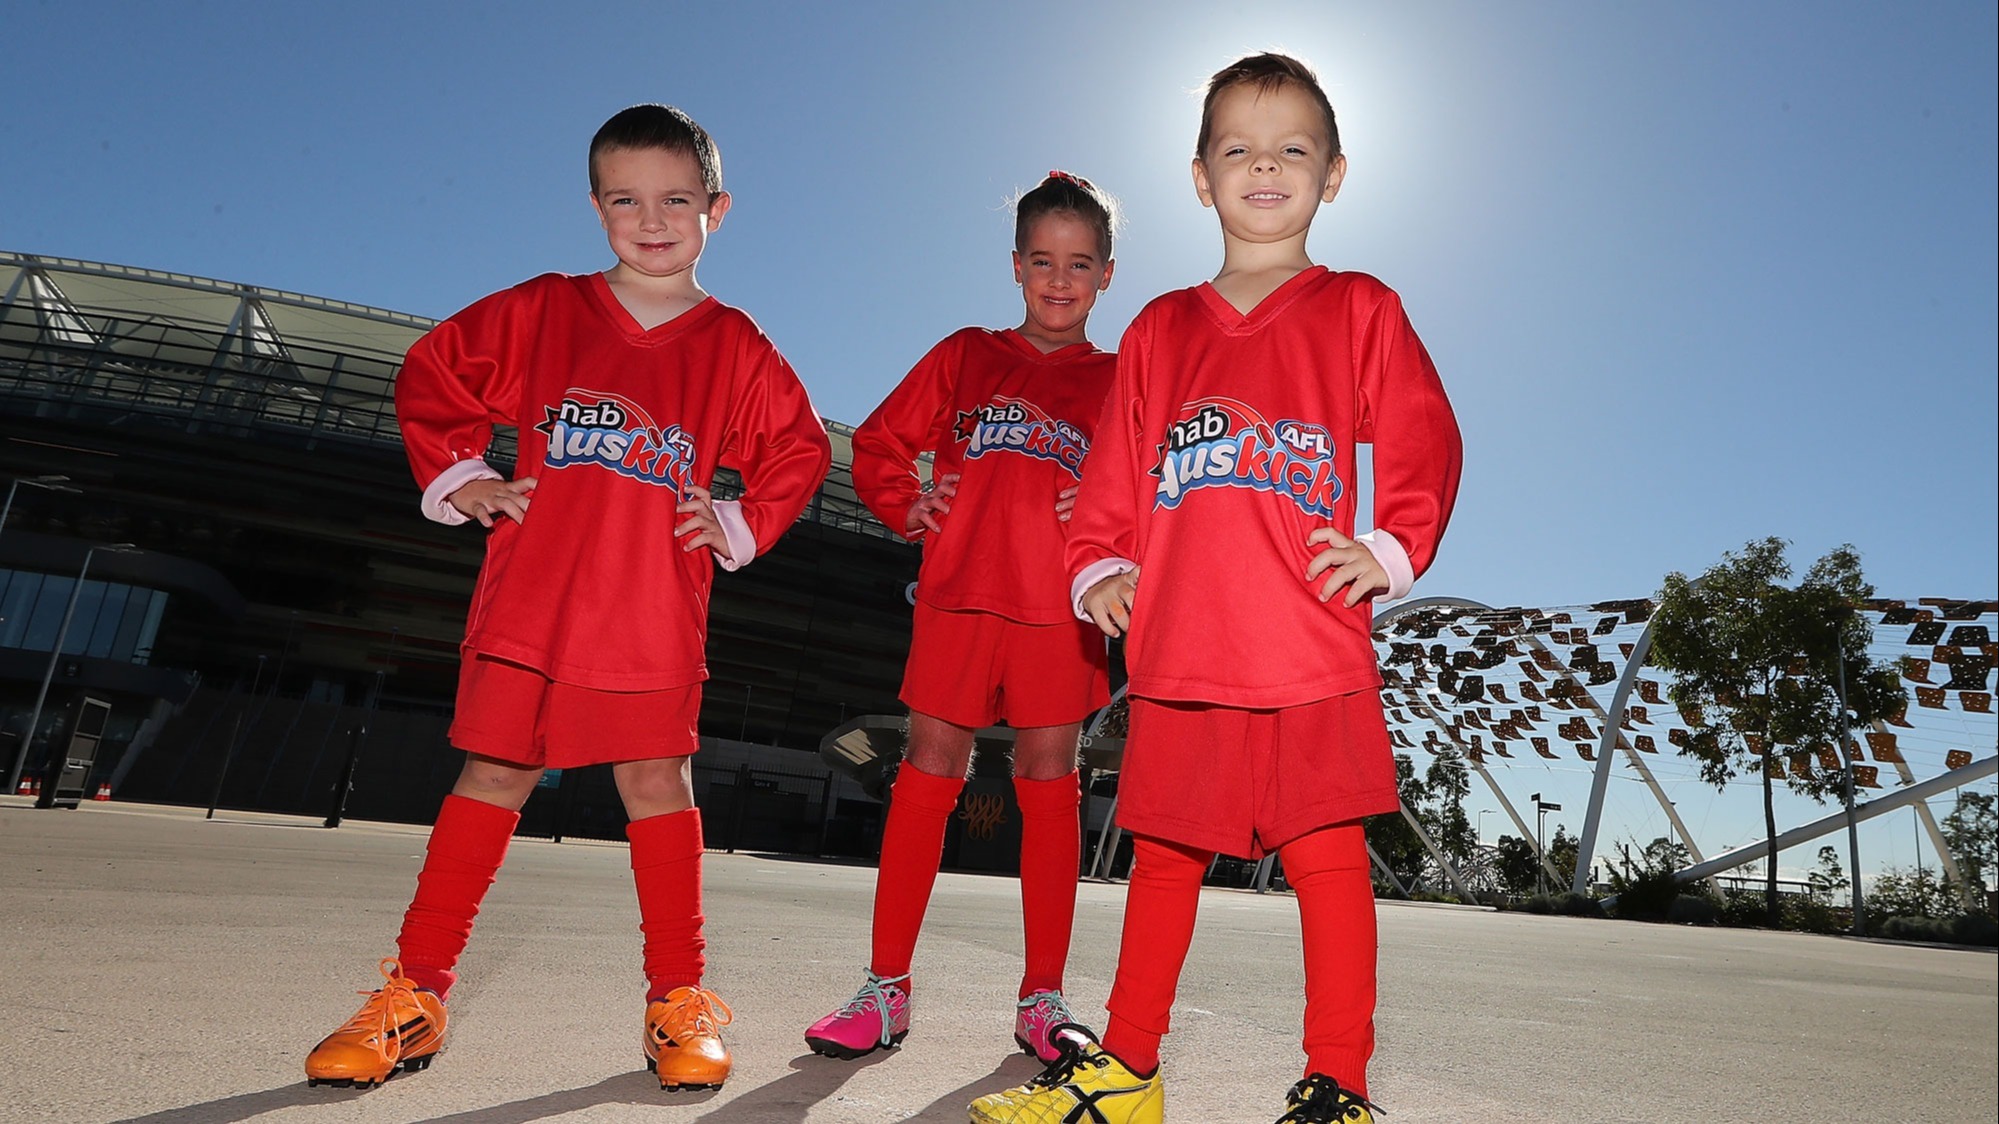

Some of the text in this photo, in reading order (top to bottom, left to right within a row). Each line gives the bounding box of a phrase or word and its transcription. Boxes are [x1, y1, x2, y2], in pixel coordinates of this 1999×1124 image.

[560, 403, 621, 426] nab
[1169, 411, 1224, 449] nab
[1281, 424, 1331, 456] AFL
